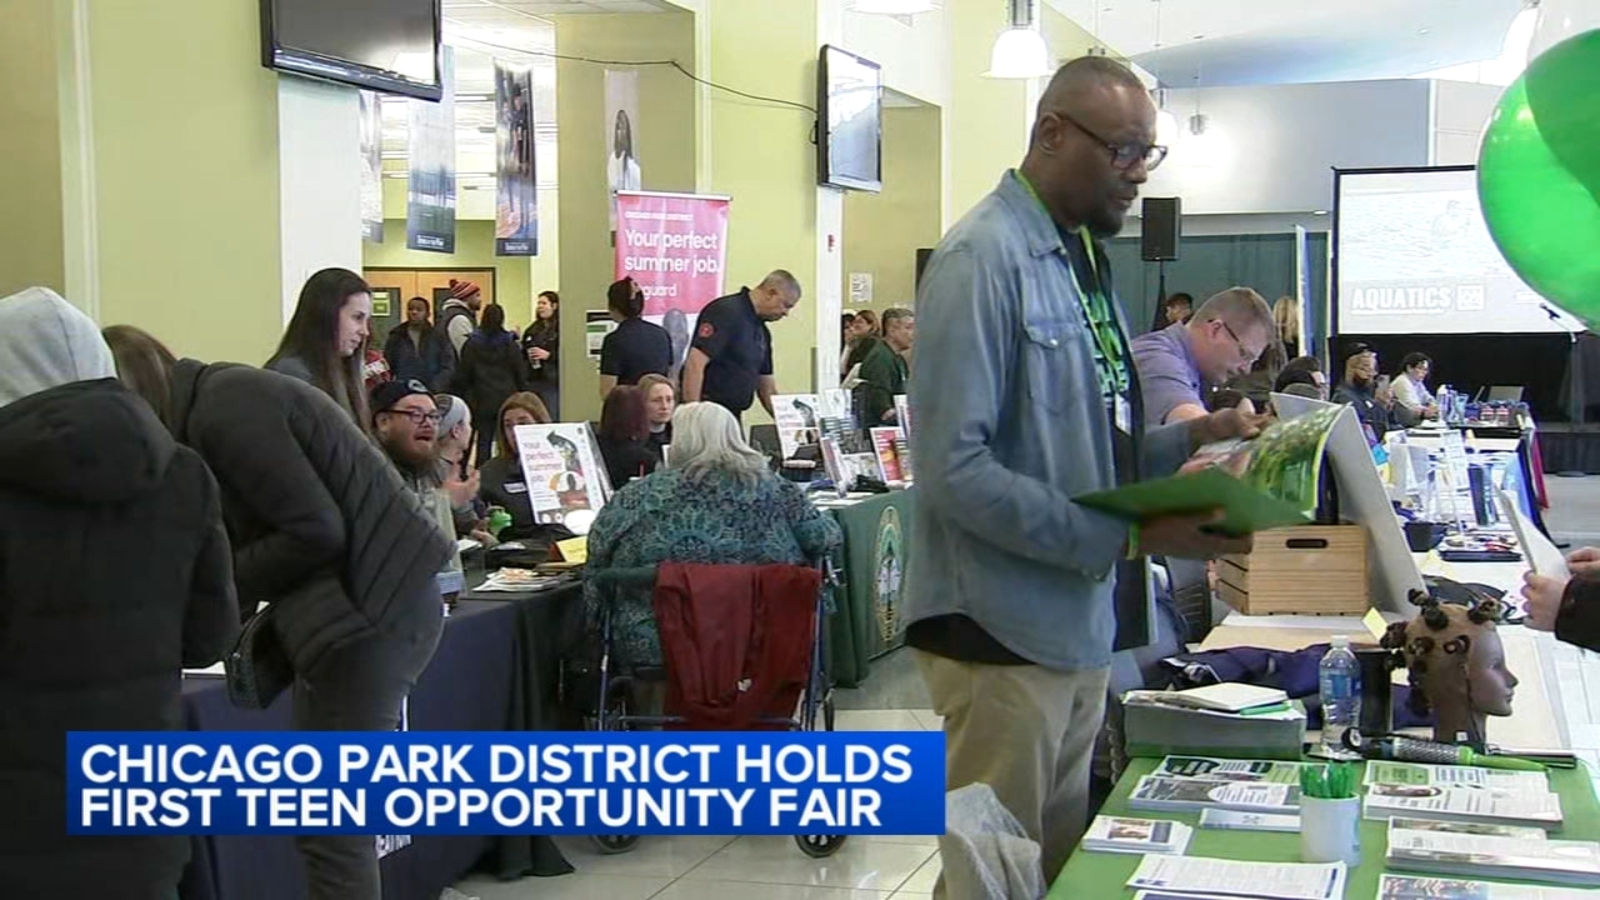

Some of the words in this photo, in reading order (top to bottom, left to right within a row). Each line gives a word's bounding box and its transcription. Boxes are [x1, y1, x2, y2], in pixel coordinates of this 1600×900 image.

[625, 229, 659, 247] Your
[662, 230, 718, 254] perfect
[624, 256, 690, 272] summer
[642, 283, 677, 300] guard
[1352, 286, 1451, 311] AQUATICS
[525, 450, 555, 461] perfect
